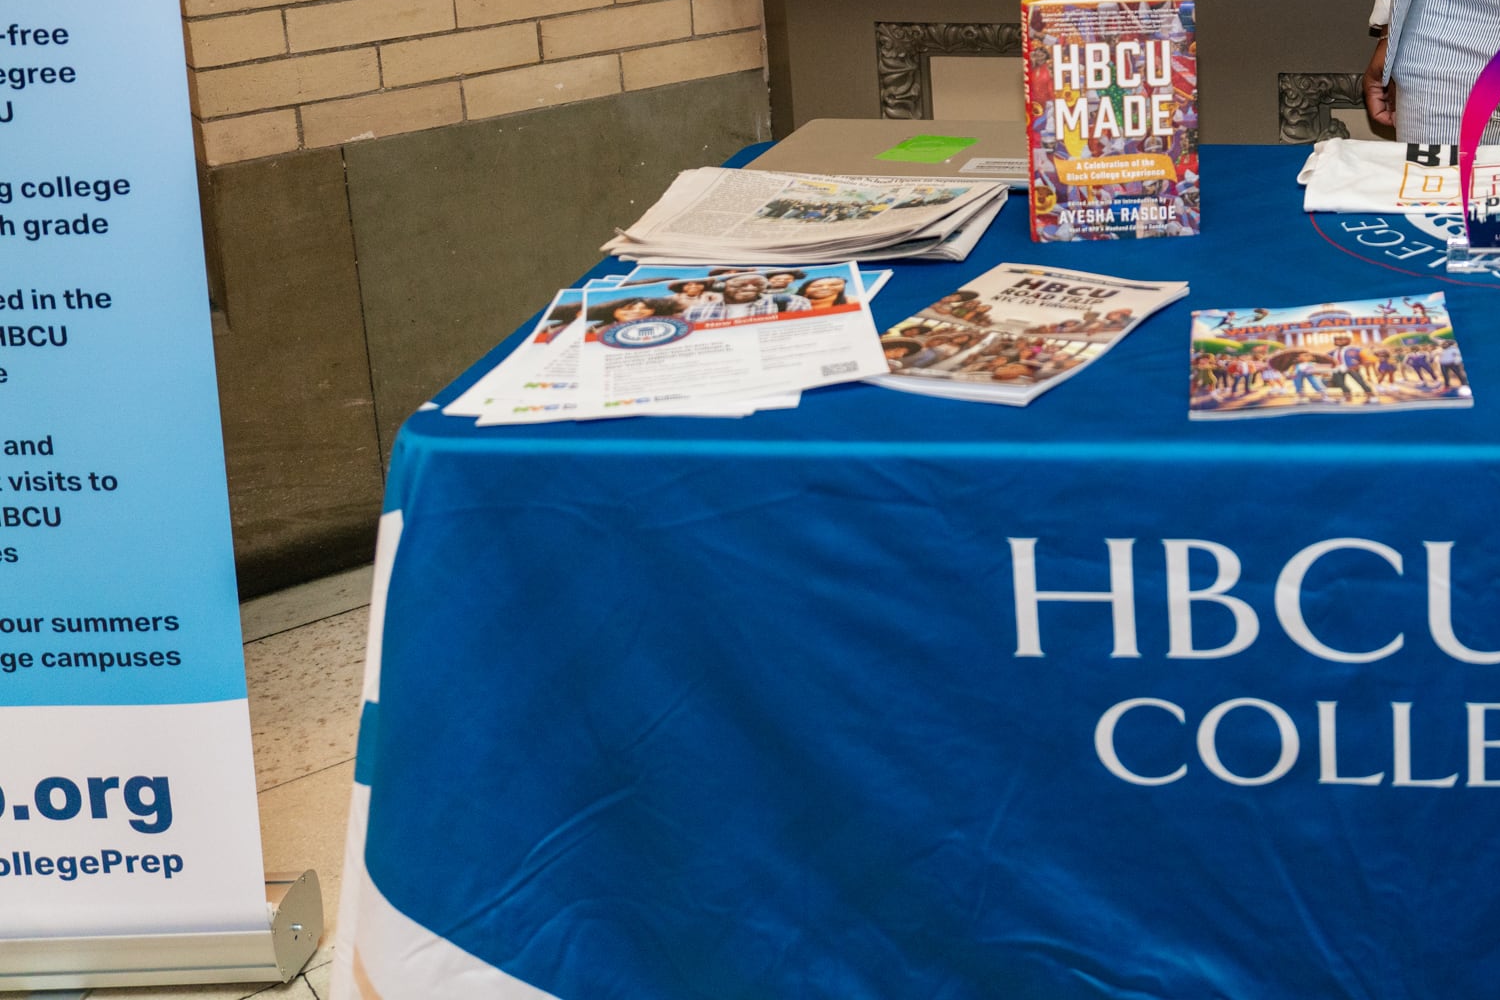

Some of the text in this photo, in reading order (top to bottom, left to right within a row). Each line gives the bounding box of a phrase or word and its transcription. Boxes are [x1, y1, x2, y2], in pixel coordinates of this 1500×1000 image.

[1053, 40, 1172, 92] HBCU
[1055, 94, 1174, 141] MADE
[1066, 169, 1166, 181] Black College Experience
[1076, 162, 1082, 170] A
[1083, 161, 1129, 170] Celebration
[1141, 159, 1155, 167] the
[21, 176, 131, 202] college
[1059, 205, 1176, 225] AYESHA RASCOE
[23, 213, 109, 241] grade
[31, 289, 56, 310] in
[62, 288, 112, 309] the
[1000, 288, 1105, 305] ROAD TRIP
[1012, 277, 1121, 299] HBCU
[1039, 300, 1093, 311] VIRGINIA
[1224, 321, 1313, 336] WHAT'S
[1318, 318, 1350, 328] AN
[4, 435, 54, 456] and
[8, 471, 118, 492] visits to
[0, 506, 62, 528] BCU
[51, 611, 181, 634] summers
[41, 646, 182, 672] campuses
[0, 775, 173, 834] .org
